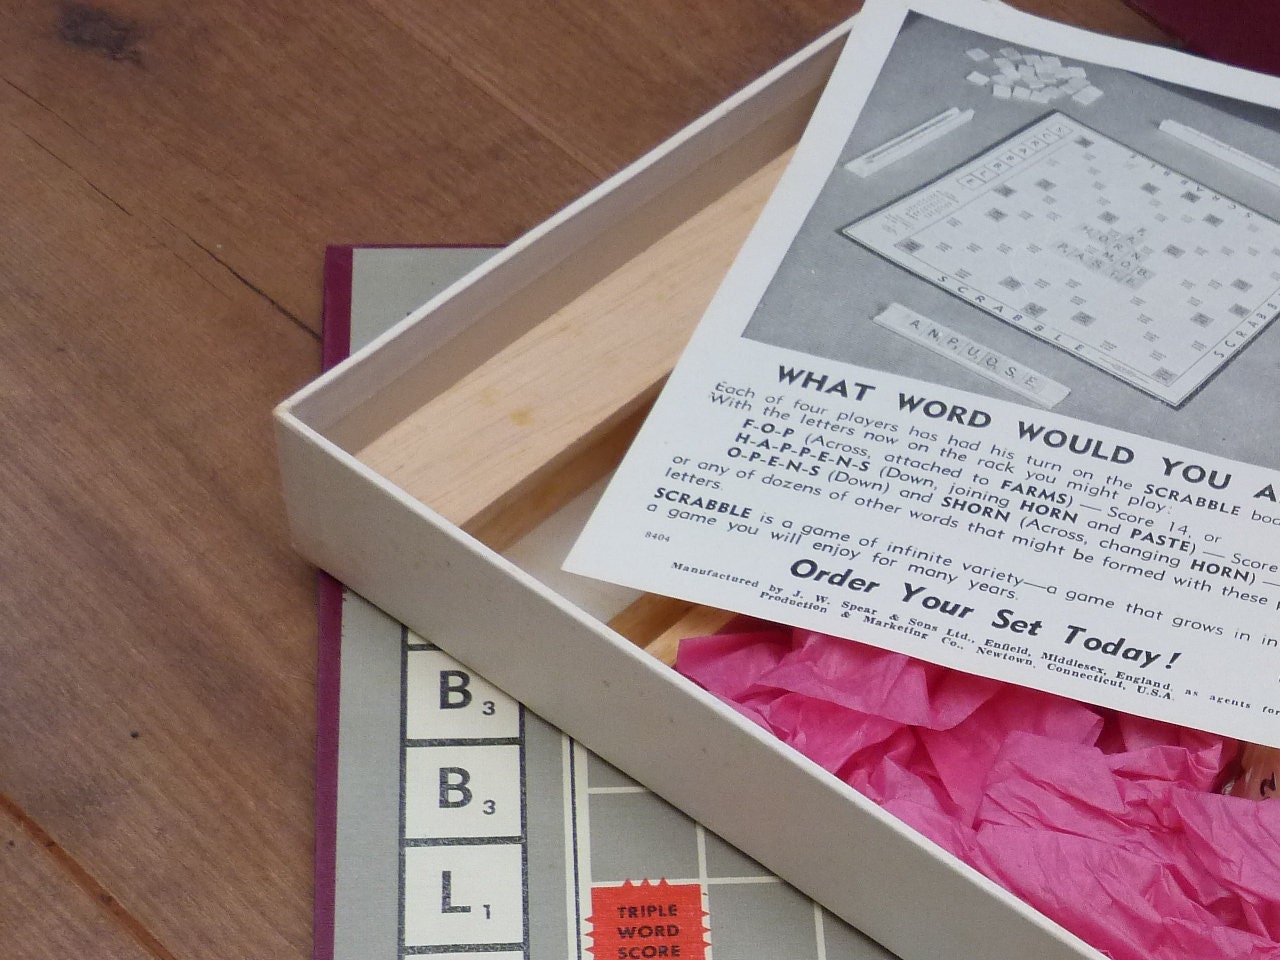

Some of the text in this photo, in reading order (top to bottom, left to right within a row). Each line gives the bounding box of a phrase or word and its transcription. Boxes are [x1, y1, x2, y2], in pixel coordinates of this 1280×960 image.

[715, 382, 755, 398] Each
[765, 396, 784, 404] of
[794, 399, 828, 415] four
[836, 411, 898, 432] players
[909, 425, 938, 441] has
[947, 434, 981, 451] had
[990, 444, 1014, 459] his
[1027, 456, 1062, 472] turn
[1073, 469, 1094, 480] on
[1106, 475, 1132, 490] the
[1144, 484, 1241, 516] SCRABBLE
[742, 418, 795, 438] F-O-P
[884, 454, 963, 478] attached
[973, 473, 989, 485] to
[1000, 480, 1073, 506] FARMS)
[1107, 506, 1154, 527] Score
[1204, 534, 1222, 543] or
[779, 365, 876, 401] WHAT
[899, 393, 991, 428] WORD
[1019, 421, 1136, 464] WOULD
[1161, 456, 1232, 490] YOU
[671, 562, 759, 587] Manufactured
[769, 584, 784, 594] by
[841, 601, 877, 615] Spear
[908, 618, 939, 632] Sons
[945, 628, 975, 643] Ltd.,
[984, 639, 1031, 657] Enfield,
[1040, 652, 1107, 676] Middlesex,
[1209, 696, 1251, 708] agents
[1263, 706, 1280, 715] for
[760, 591, 827, 613] Production
[863, 615, 929, 640] Marketing
[1047, 663, 1133, 690] Connecticut,
[790, 559, 1182, 669] Order Your Set Today!
[617, 904, 677, 918] TRIPLE
[617, 925, 679, 939] WORD
[618, 945, 680, 959] SCORE
